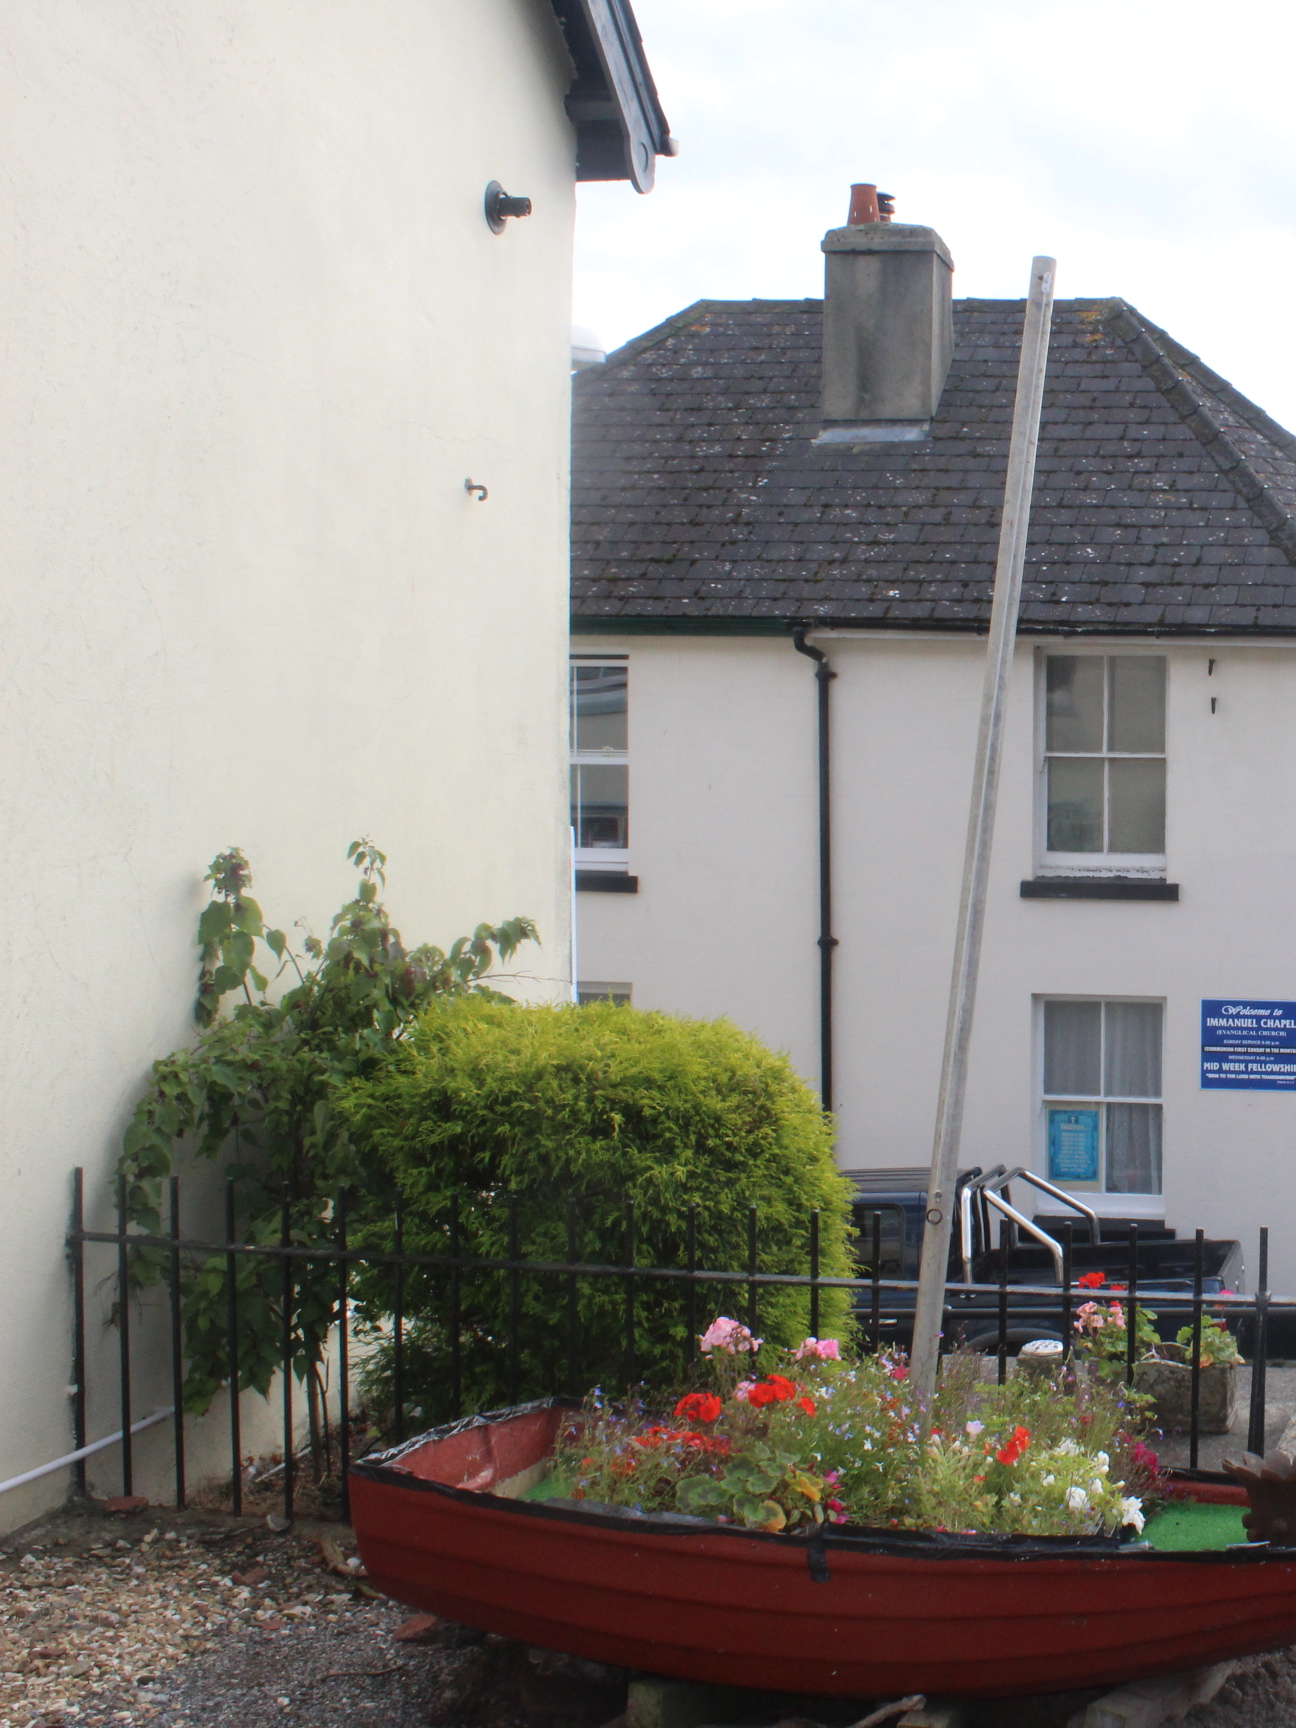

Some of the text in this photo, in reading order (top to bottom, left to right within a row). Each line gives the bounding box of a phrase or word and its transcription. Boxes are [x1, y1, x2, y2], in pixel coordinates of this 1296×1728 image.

[1221, 1005, 1283, 1016] Welcome to
[1206, 1017, 1296, 1029] IMMANUEL CHAPEL
[1203, 1062, 1220, 1070] MID
[1221, 1062, 1246, 1071] WEEK
